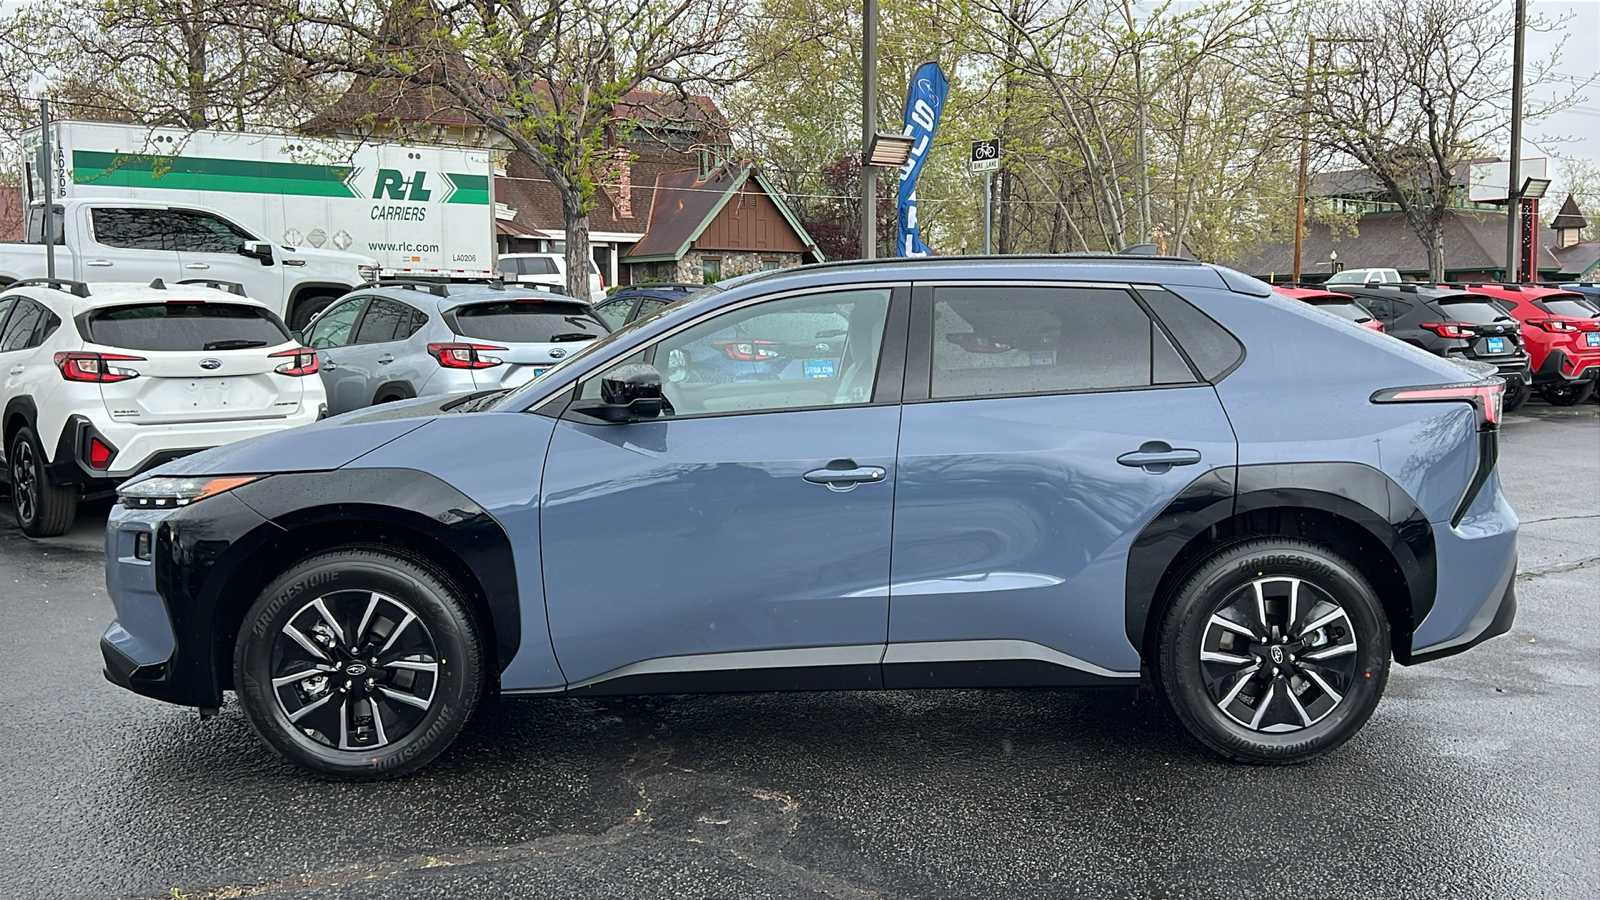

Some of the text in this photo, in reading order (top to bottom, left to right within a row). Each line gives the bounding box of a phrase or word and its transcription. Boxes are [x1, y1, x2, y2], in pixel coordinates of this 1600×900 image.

[58, 140, 66, 197] LA0206
[974, 160, 997, 170] BIKE LANE
[371, 205, 426, 221] CARRIERS
[368, 242, 439, 252] www.rlc.com
[453, 254, 477, 262] LA0206
[1238, 555, 1339, 580] BRIDGESTONE
[252, 571, 340, 639] BRIDGESTONE
[371, 703, 452, 770] BRIDGESTONE
